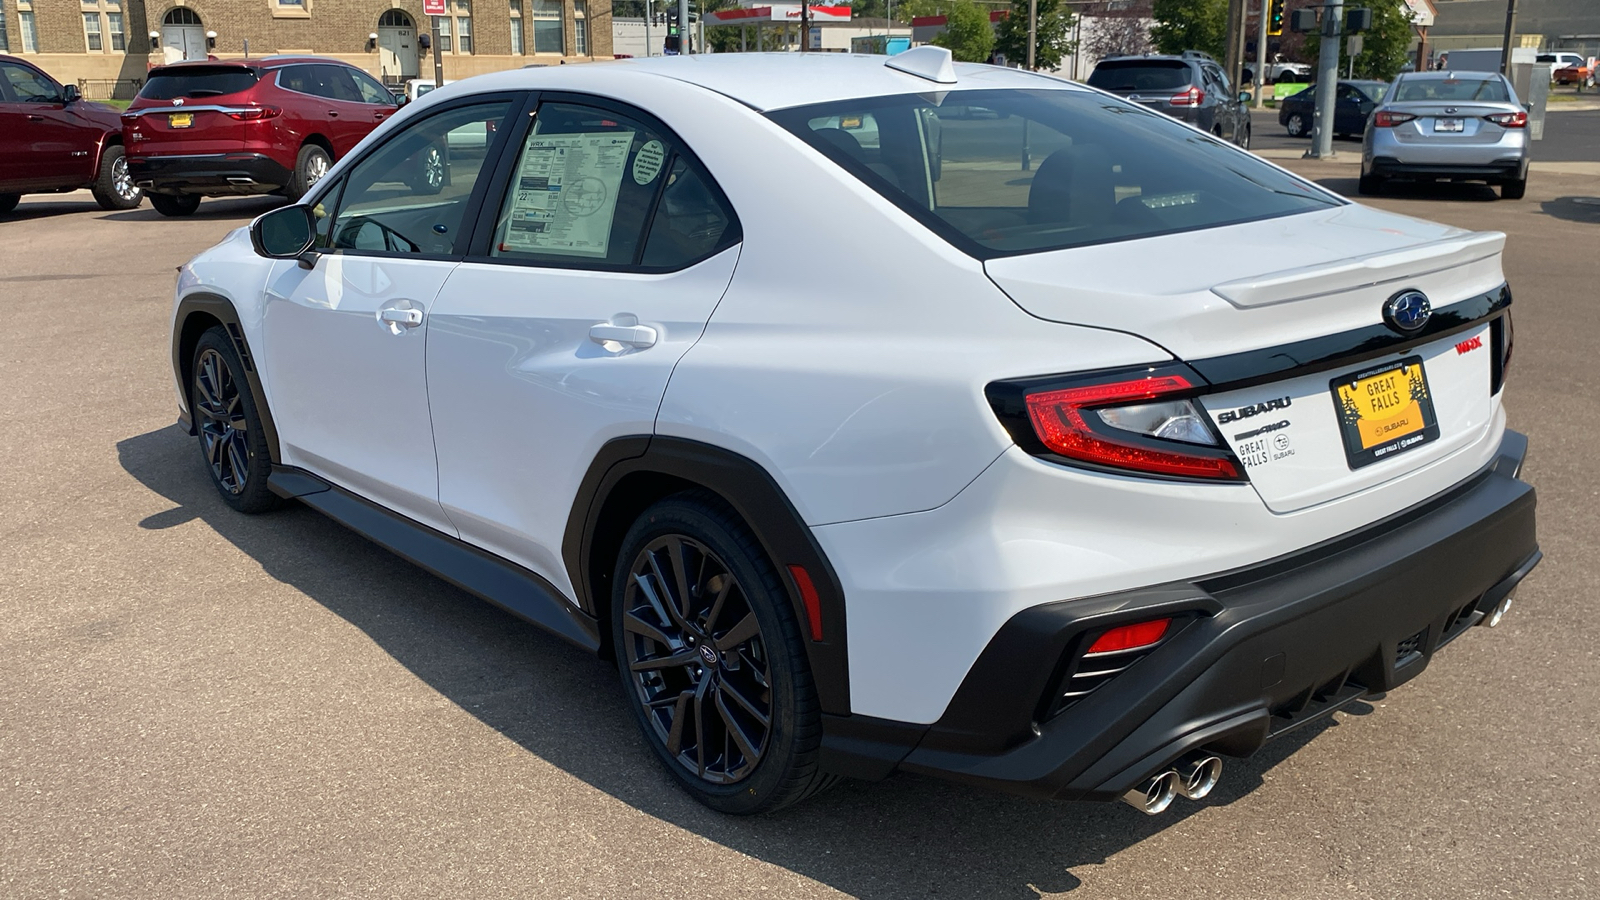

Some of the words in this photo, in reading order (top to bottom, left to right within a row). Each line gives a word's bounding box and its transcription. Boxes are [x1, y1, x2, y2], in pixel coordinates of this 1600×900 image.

[1455, 336, 1483, 356] WRX
[1366, 376, 1396, 396] GREAT
[1217, 396, 1292, 425] SUBARU
[1370, 391, 1400, 413] FALLS
[1258, 419, 1291, 434] AWD
[1383, 418, 1409, 433] SUBARU
[1239, 440, 1265, 456] GREAT
[1273, 449, 1296, 461] SUBARU
[1242, 451, 1268, 469] FALLS
